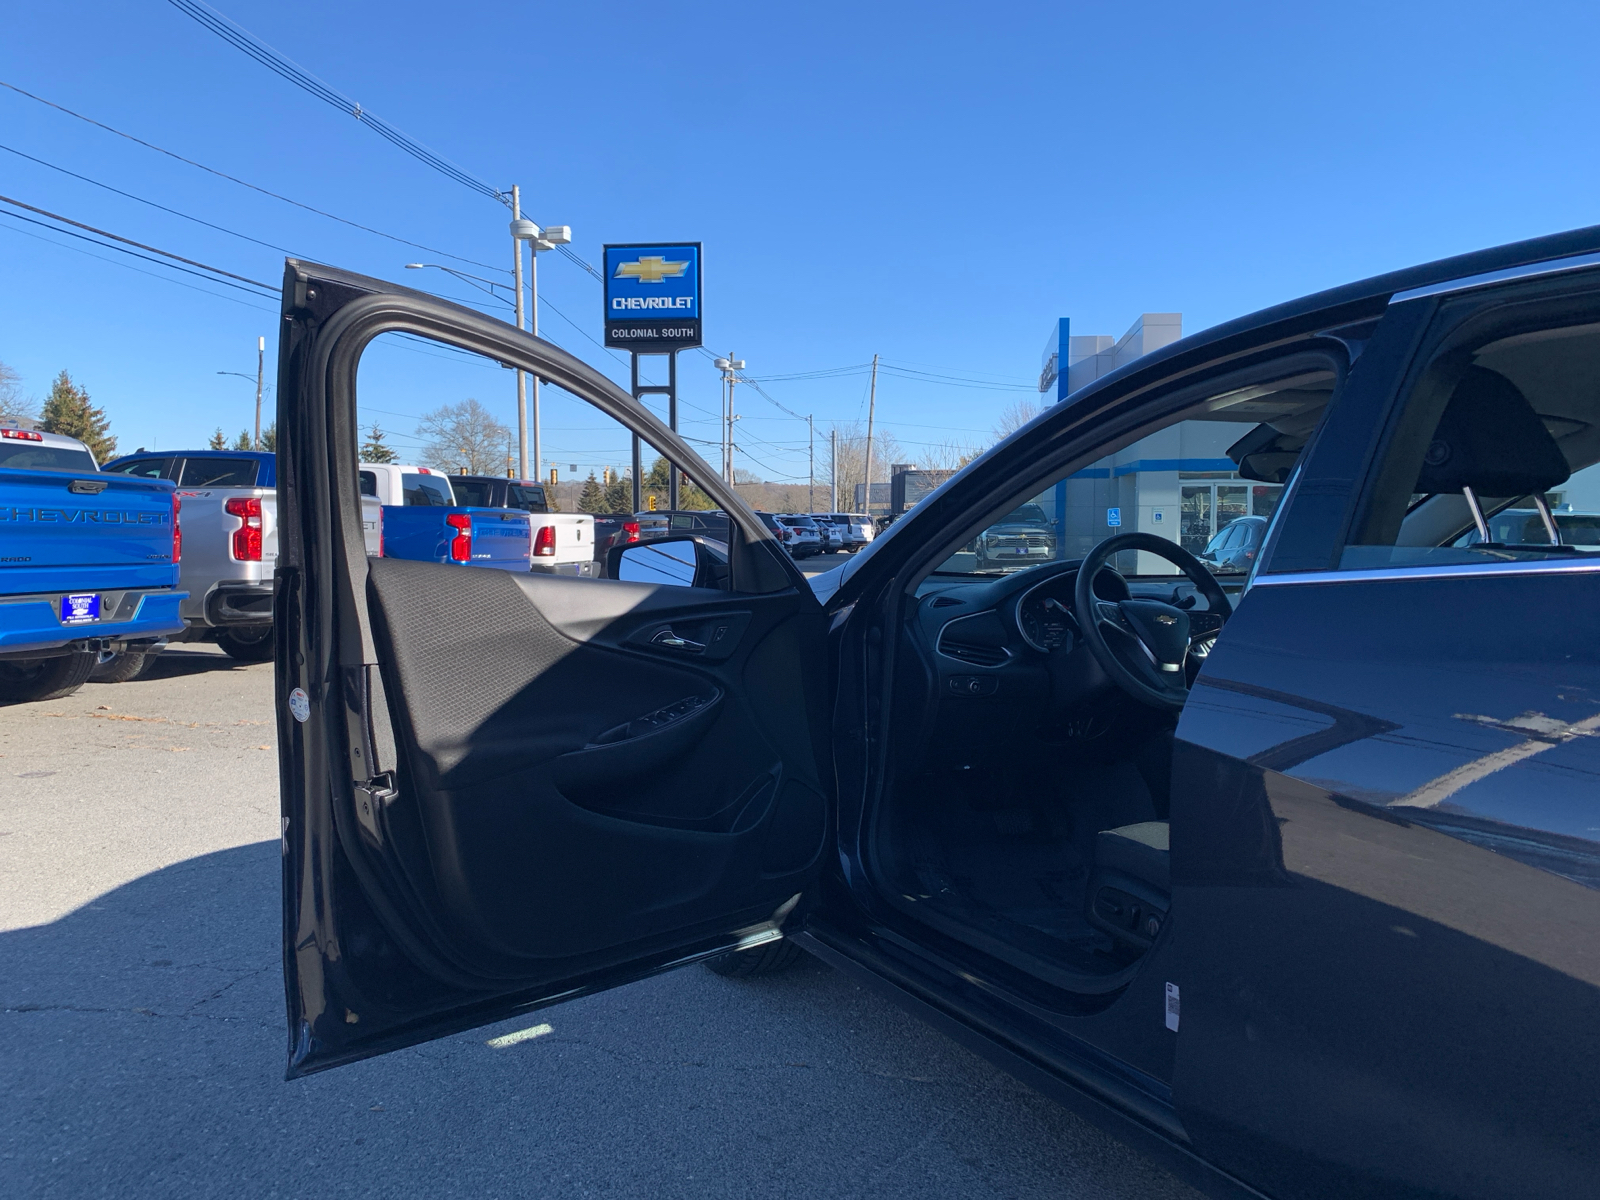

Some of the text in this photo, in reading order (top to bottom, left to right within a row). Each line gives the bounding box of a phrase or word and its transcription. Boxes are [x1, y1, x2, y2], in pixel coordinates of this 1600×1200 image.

[612, 297, 693, 310] CHEVROLET
[611, 328, 694, 338] COLONIAL SOUTH
